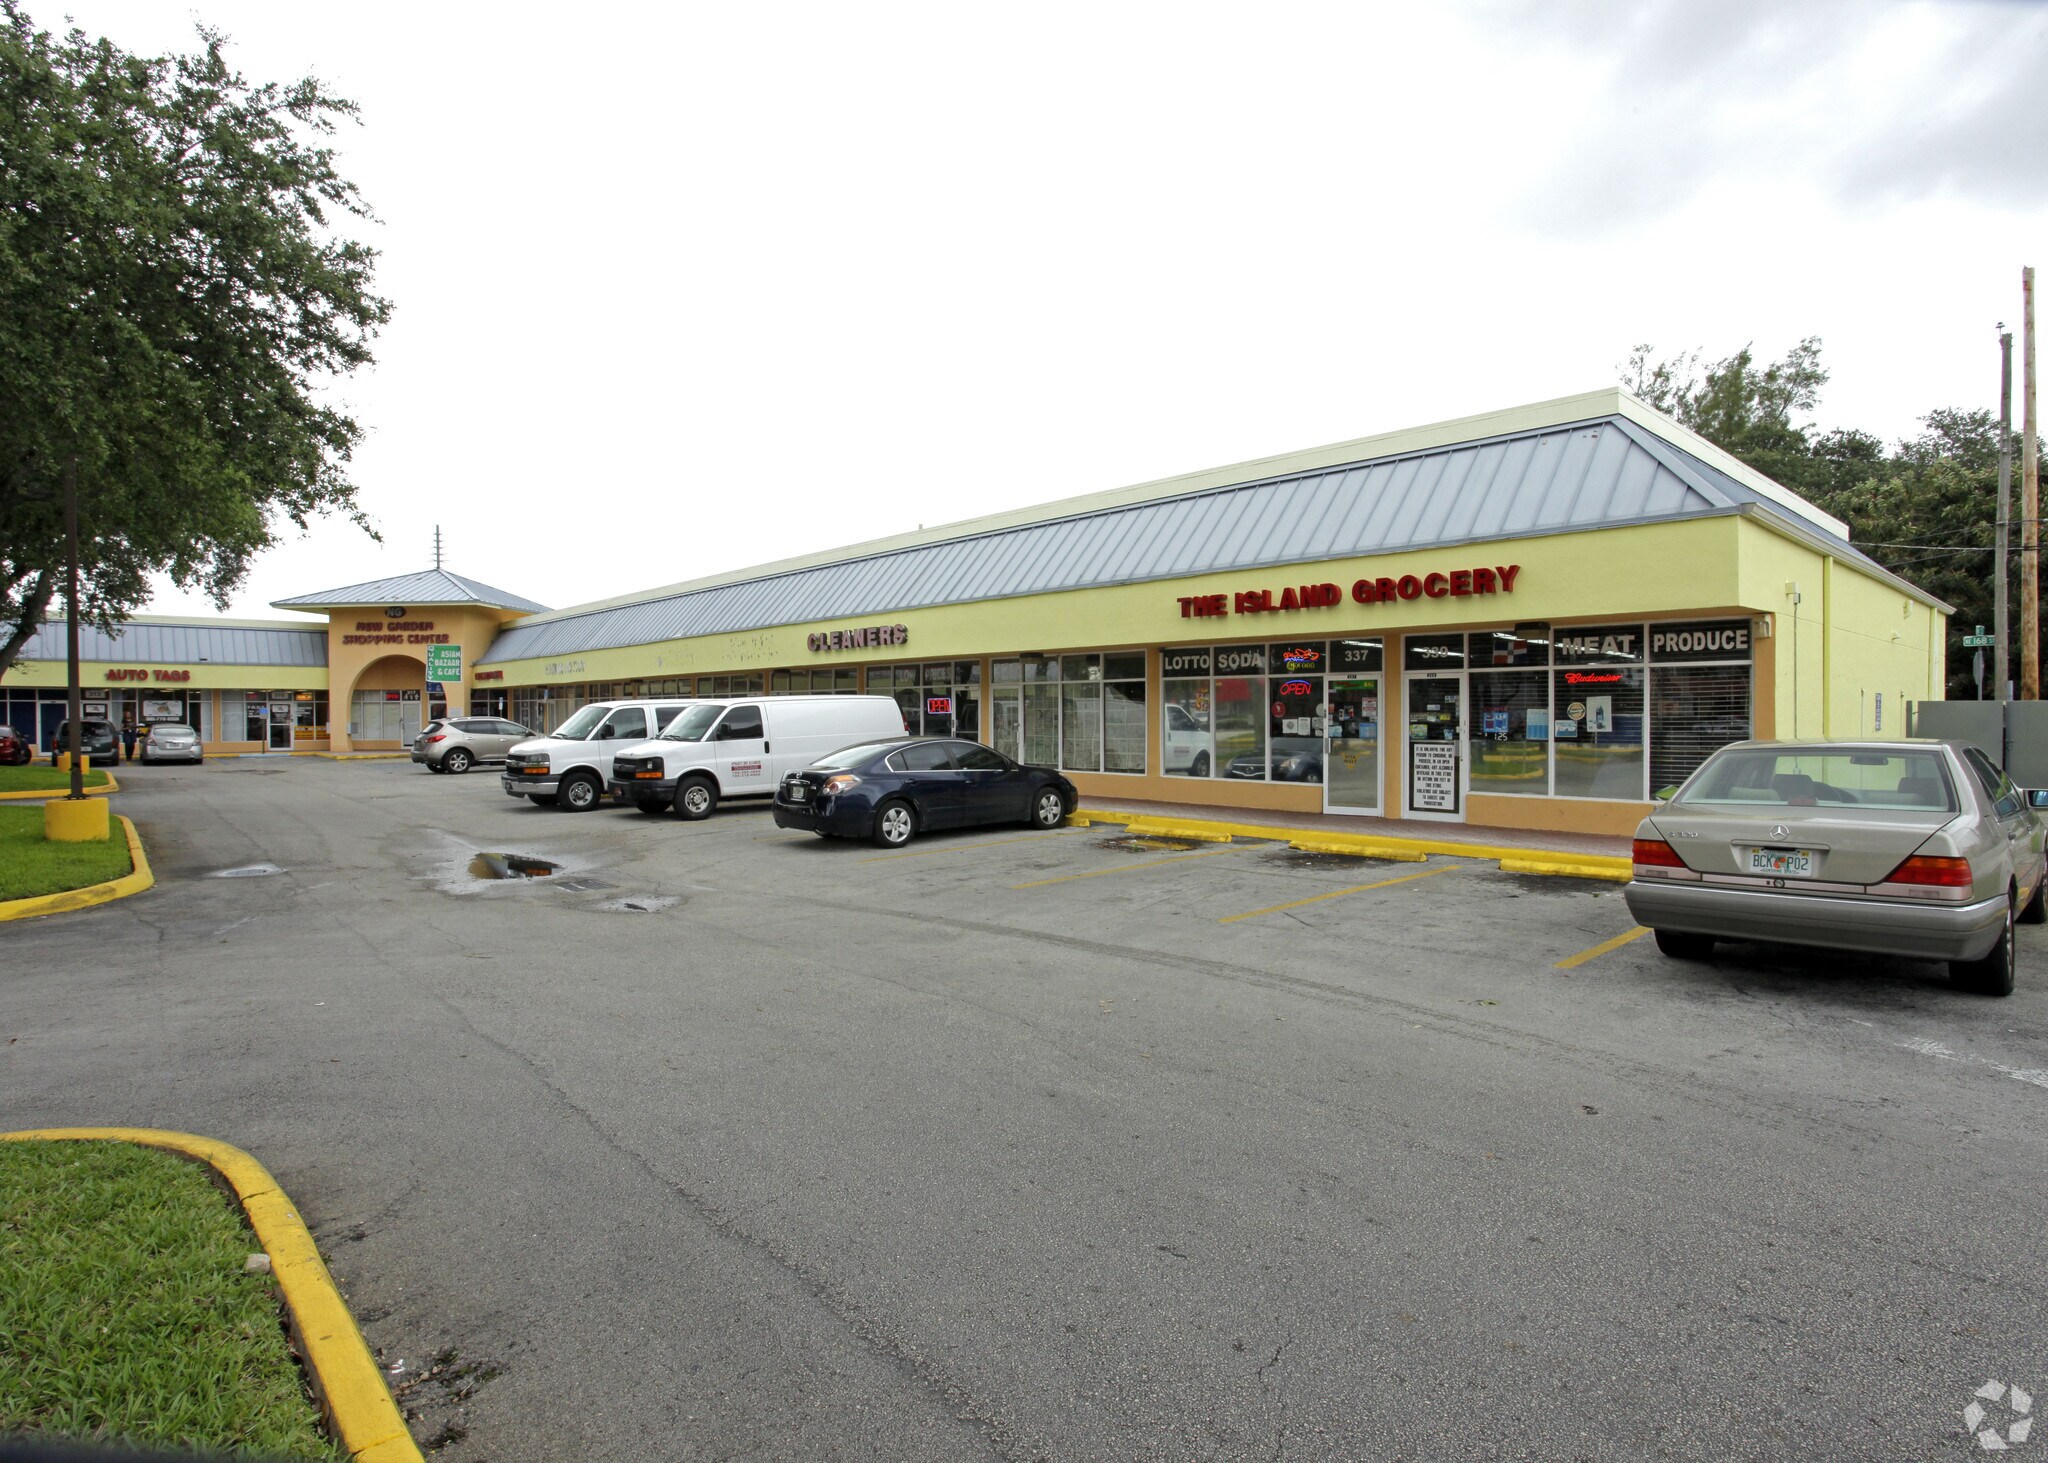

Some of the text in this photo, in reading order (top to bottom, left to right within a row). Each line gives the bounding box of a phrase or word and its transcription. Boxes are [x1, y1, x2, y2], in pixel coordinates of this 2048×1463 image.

[1177, 563, 1521, 618] THE ISLAND GROCERY
[356, 621, 434, 631] NEW GARDEN
[342, 634, 449, 645] SHOPPING CENTER
[807, 624, 908, 651] CLEANERS
[1653, 629, 1748, 653] PRODUCE
[1973, 636, 1988, 645] 168
[1562, 635, 1635, 655] MEAT
[1218, 653, 1261, 669] SODA
[1344, 650, 1369, 661] 337
[1165, 655, 1210, 670] LOTTO
[105, 669, 190, 681] AUTO TAGS
[1565, 672, 1623, 684] Budweiser
[1280, 683, 1312, 695] OPEN
[1753, 854, 1773, 868] BCK
